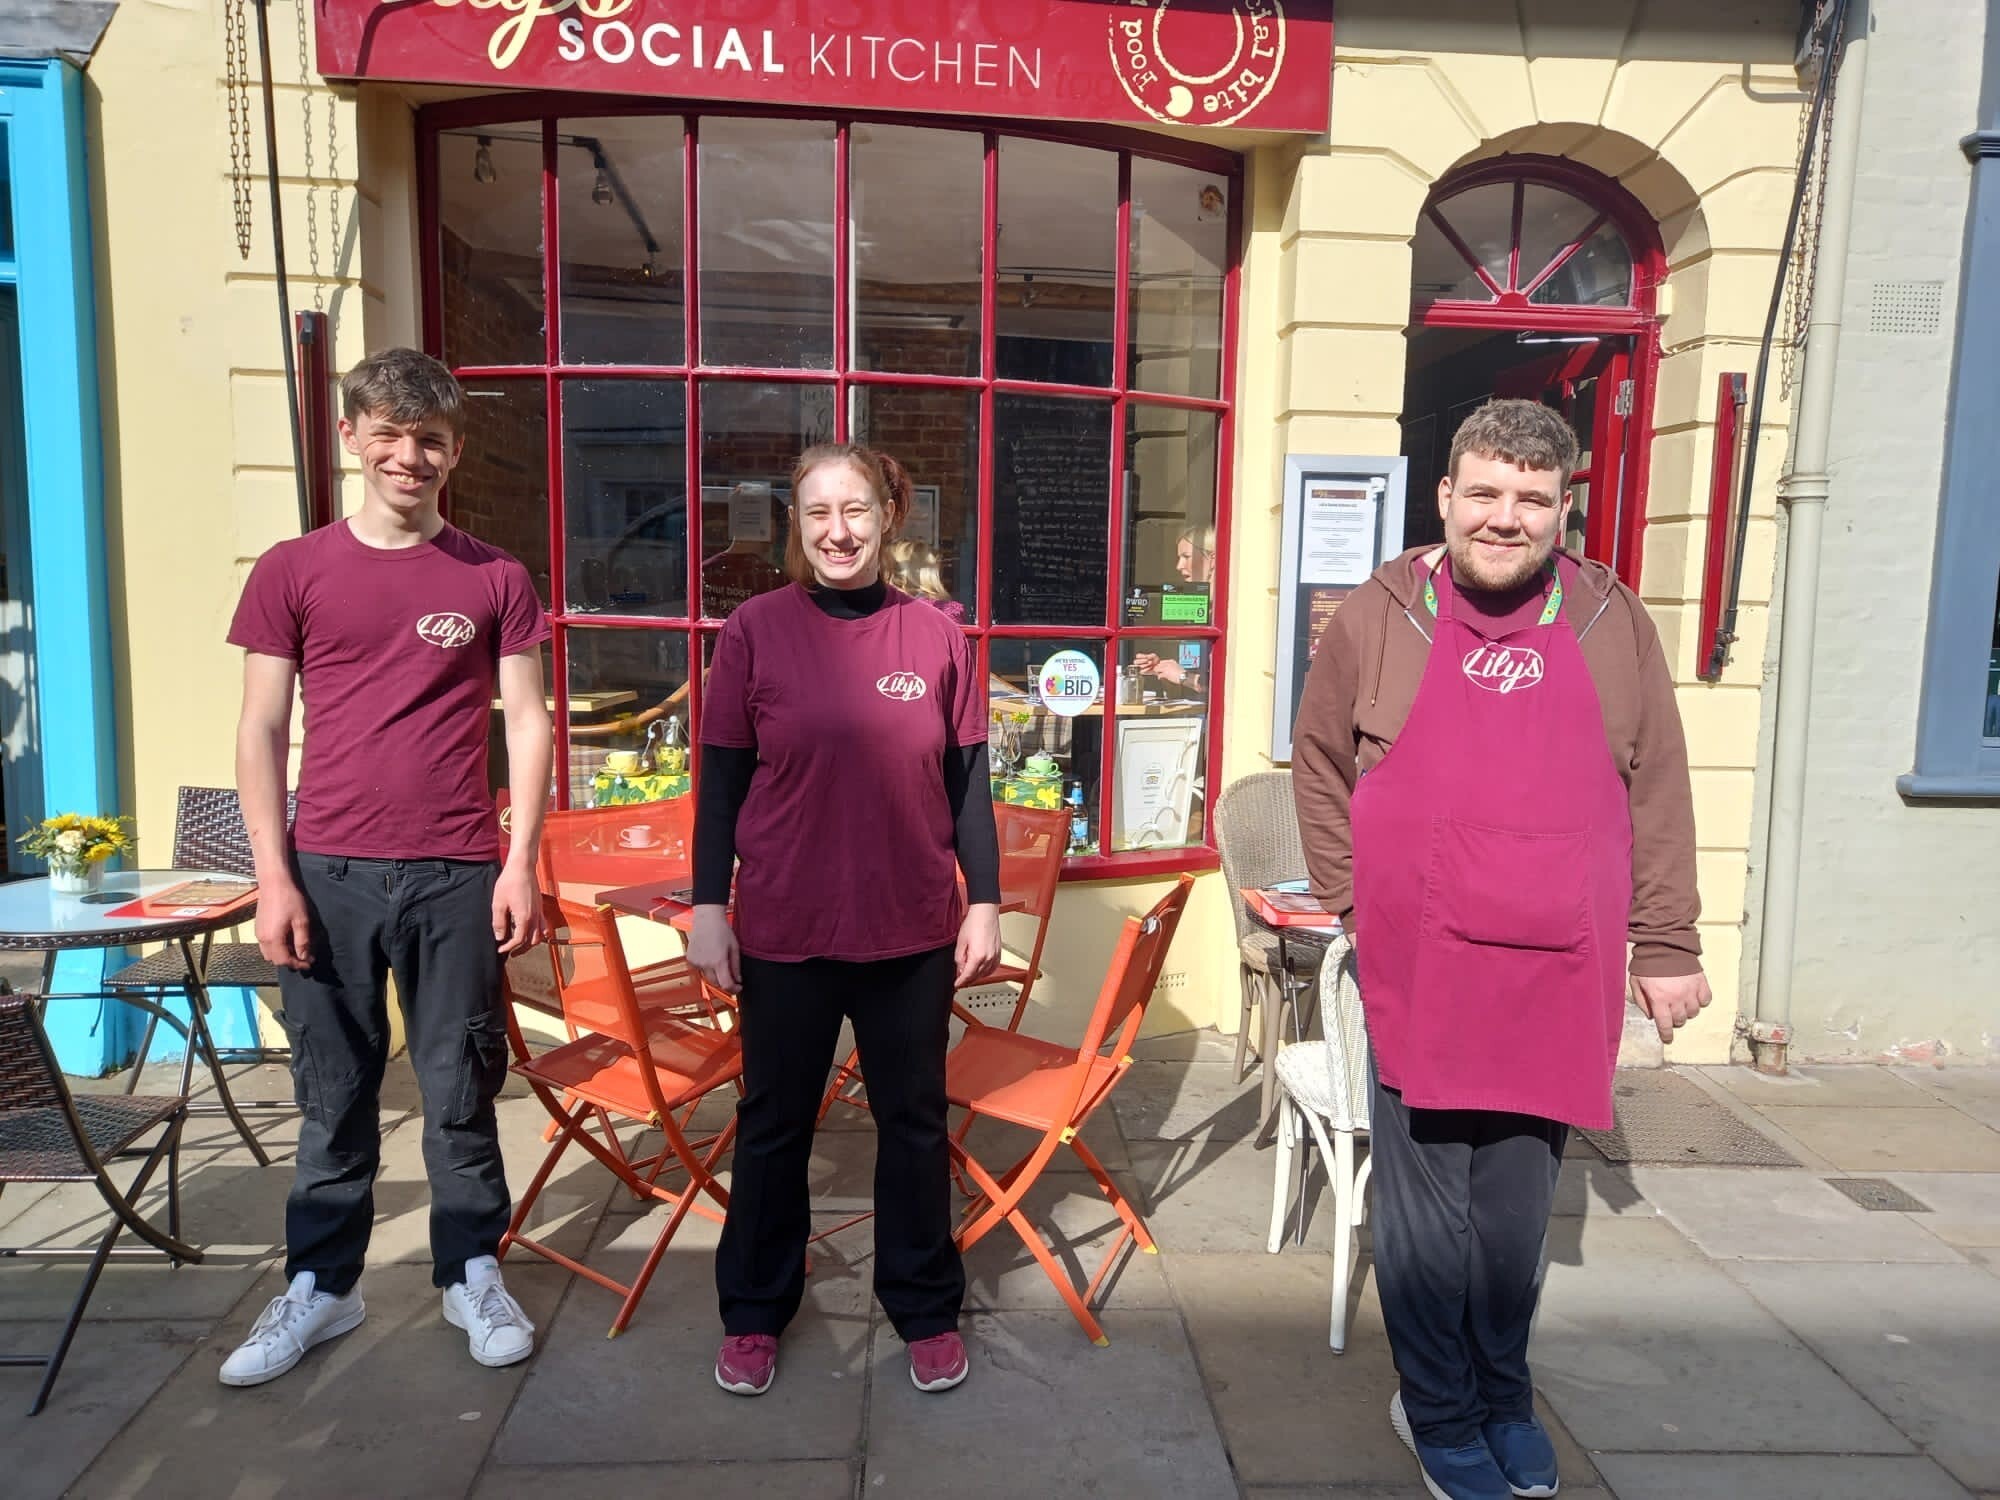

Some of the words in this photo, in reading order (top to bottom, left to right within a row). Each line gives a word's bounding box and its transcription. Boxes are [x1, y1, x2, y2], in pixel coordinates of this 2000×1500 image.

[557, 17, 785, 73] SOCIAL
[810, 32, 1042, 90] KITCHEN
[1119, 18, 1158, 93] Food
[1203, 68, 1266, 112] bite
[418, 615, 472, 648] Lily's
[1062, 663, 1078, 672] YES
[1064, 679, 1093, 696] BID
[1463, 646, 1542, 693] Lily's
